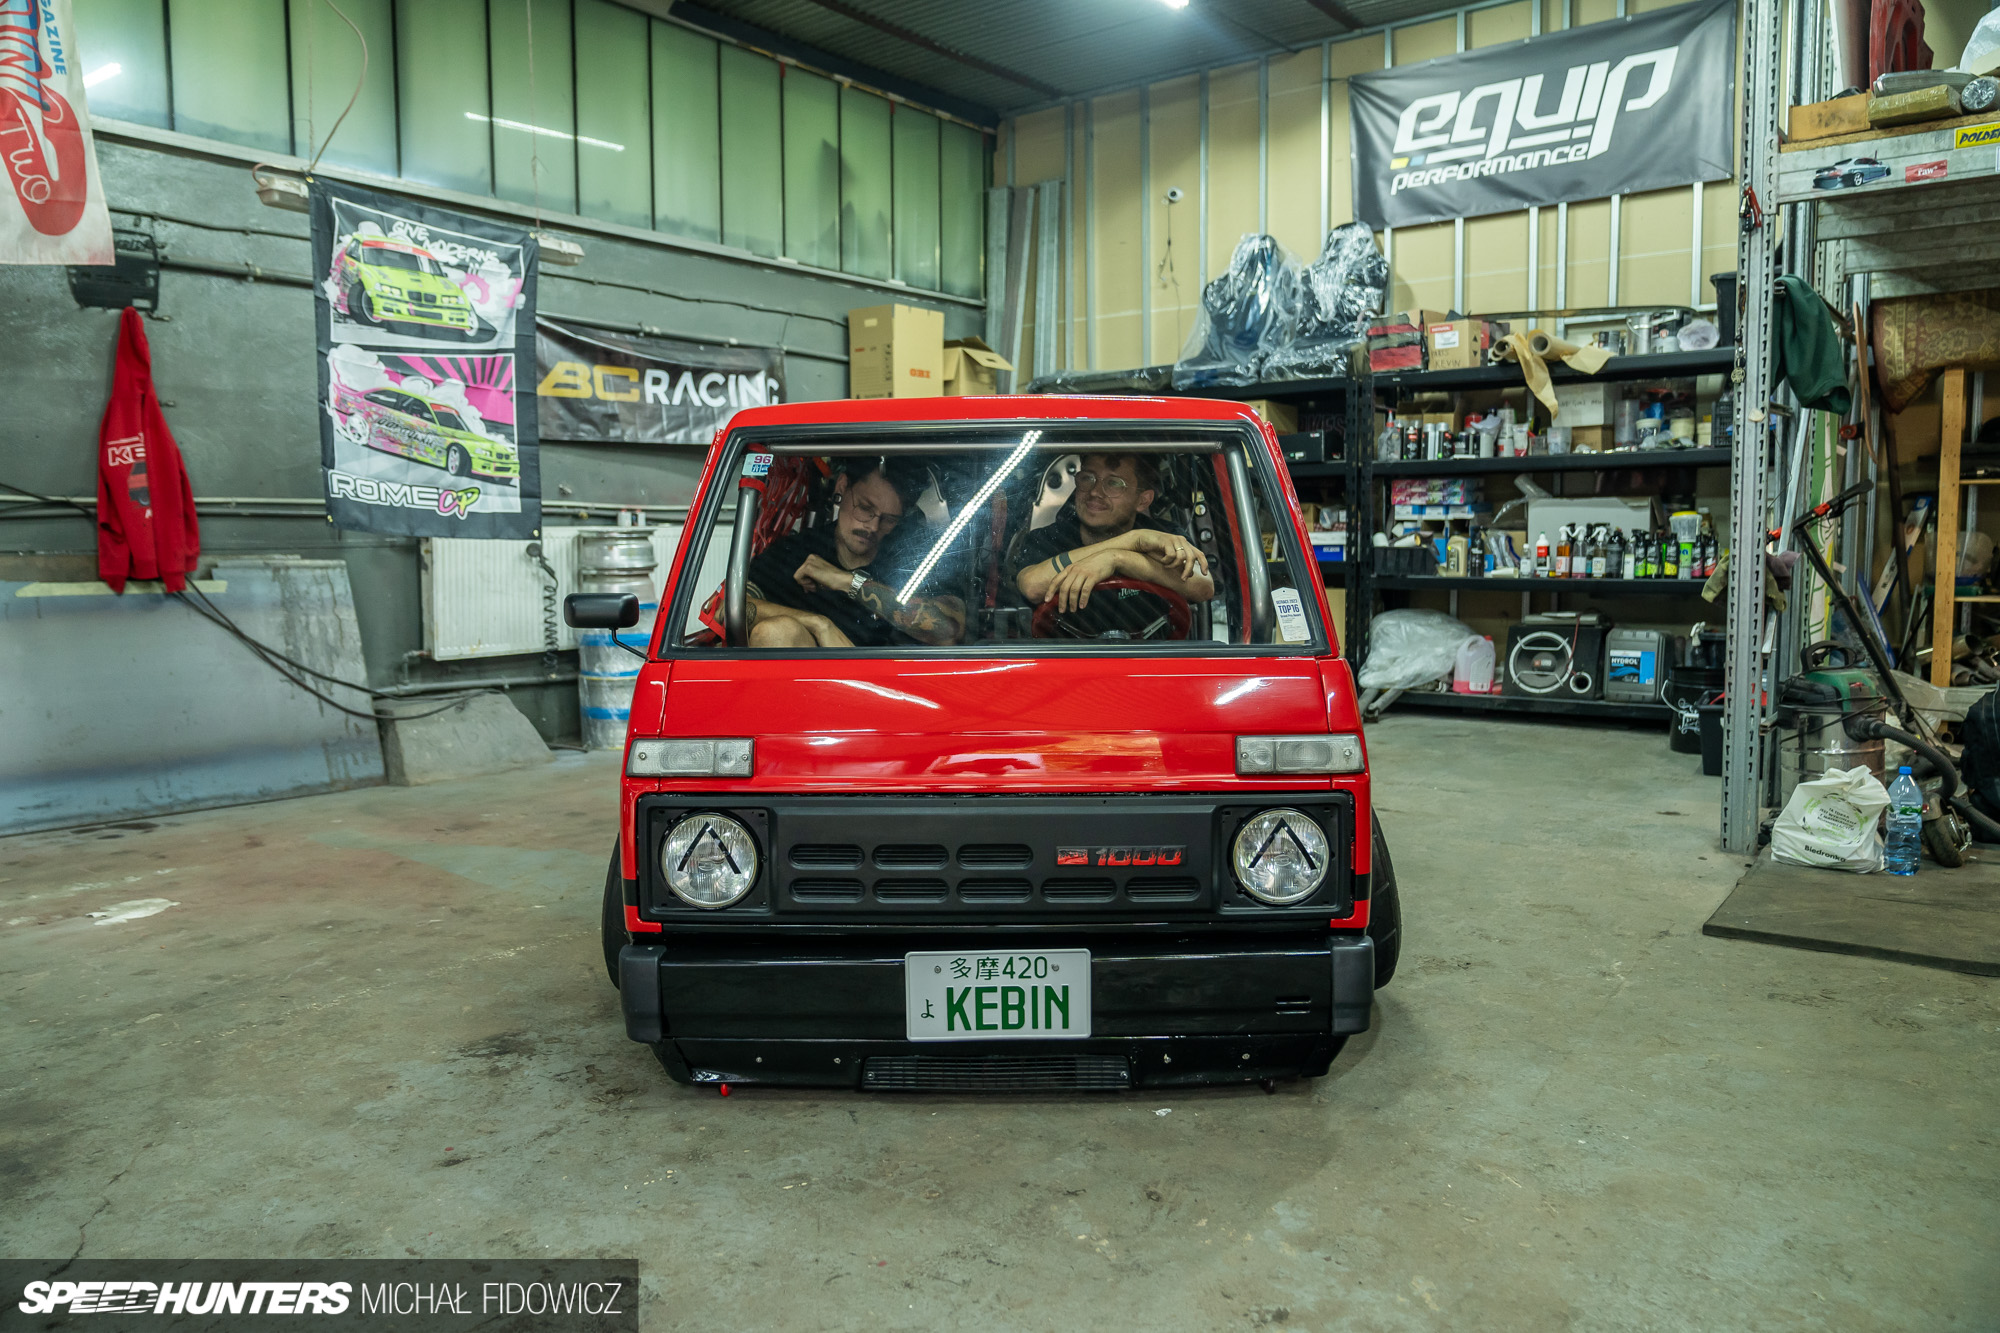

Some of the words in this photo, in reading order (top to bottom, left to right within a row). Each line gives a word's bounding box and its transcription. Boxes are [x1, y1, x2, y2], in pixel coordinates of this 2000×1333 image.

[1393, 45, 1679, 160] equip
[753, 455, 772, 464] 96
[1611, 657, 1638, 665] HYDROL
[1096, 847, 1182, 866] 1000
[1804, 845, 1846, 863] Biedronka
[920, 998, 935, 1019] よ
[946, 984, 1070, 1032] KEBIN
